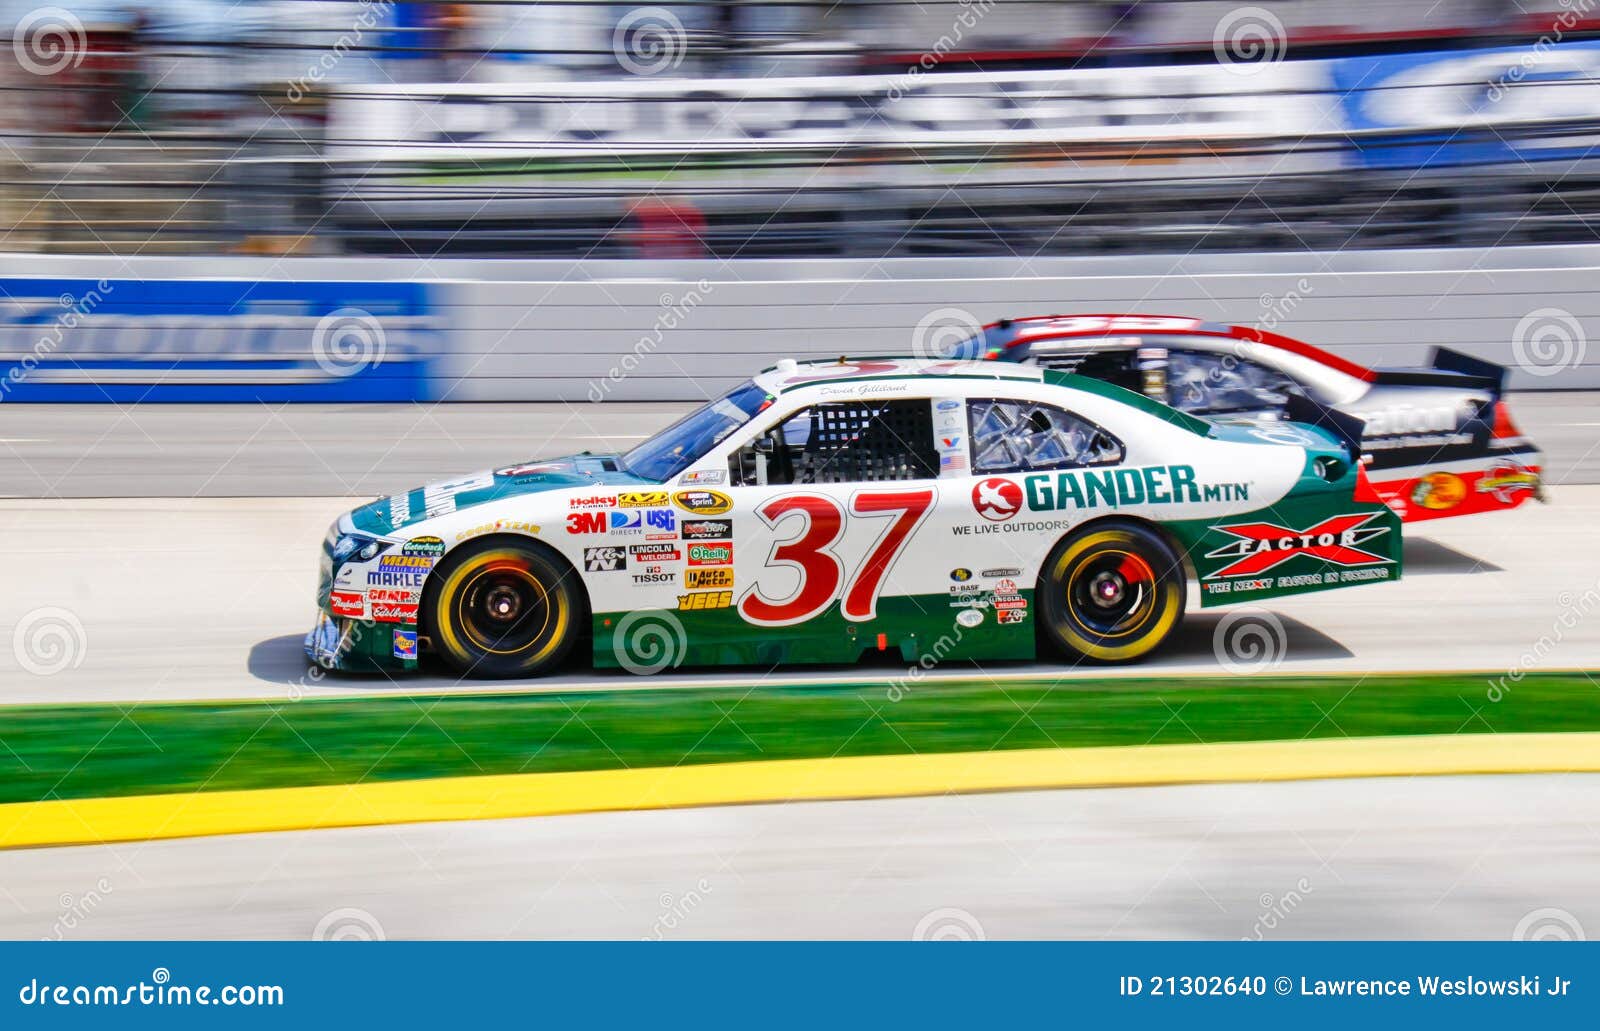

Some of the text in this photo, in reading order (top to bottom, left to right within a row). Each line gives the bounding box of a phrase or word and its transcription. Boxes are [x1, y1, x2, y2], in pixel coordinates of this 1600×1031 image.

[1025, 465, 1250, 512] GANDER MTN
[569, 496, 617, 508] Holley
[691, 499, 714, 507] Sprint
[566, 511, 607, 535] 3M
[646, 509, 676, 532] USG
[952, 520, 1070, 535] WE LIVE OUTDOORS
[631, 544, 673, 553] LINCOLN
[1238, 530, 1357, 555] FACTOR
[640, 553, 677, 561] WELDERS
[739, 485, 938, 626] 37
[367, 572, 423, 586] MAHLE
[632, 573, 677, 583] TISSOT
[699, 570, 725, 579] Auto
[1209, 567, 1389, 593] THE NEXT FACTOR IN FISHING
[368, 589, 411, 600] COMP
